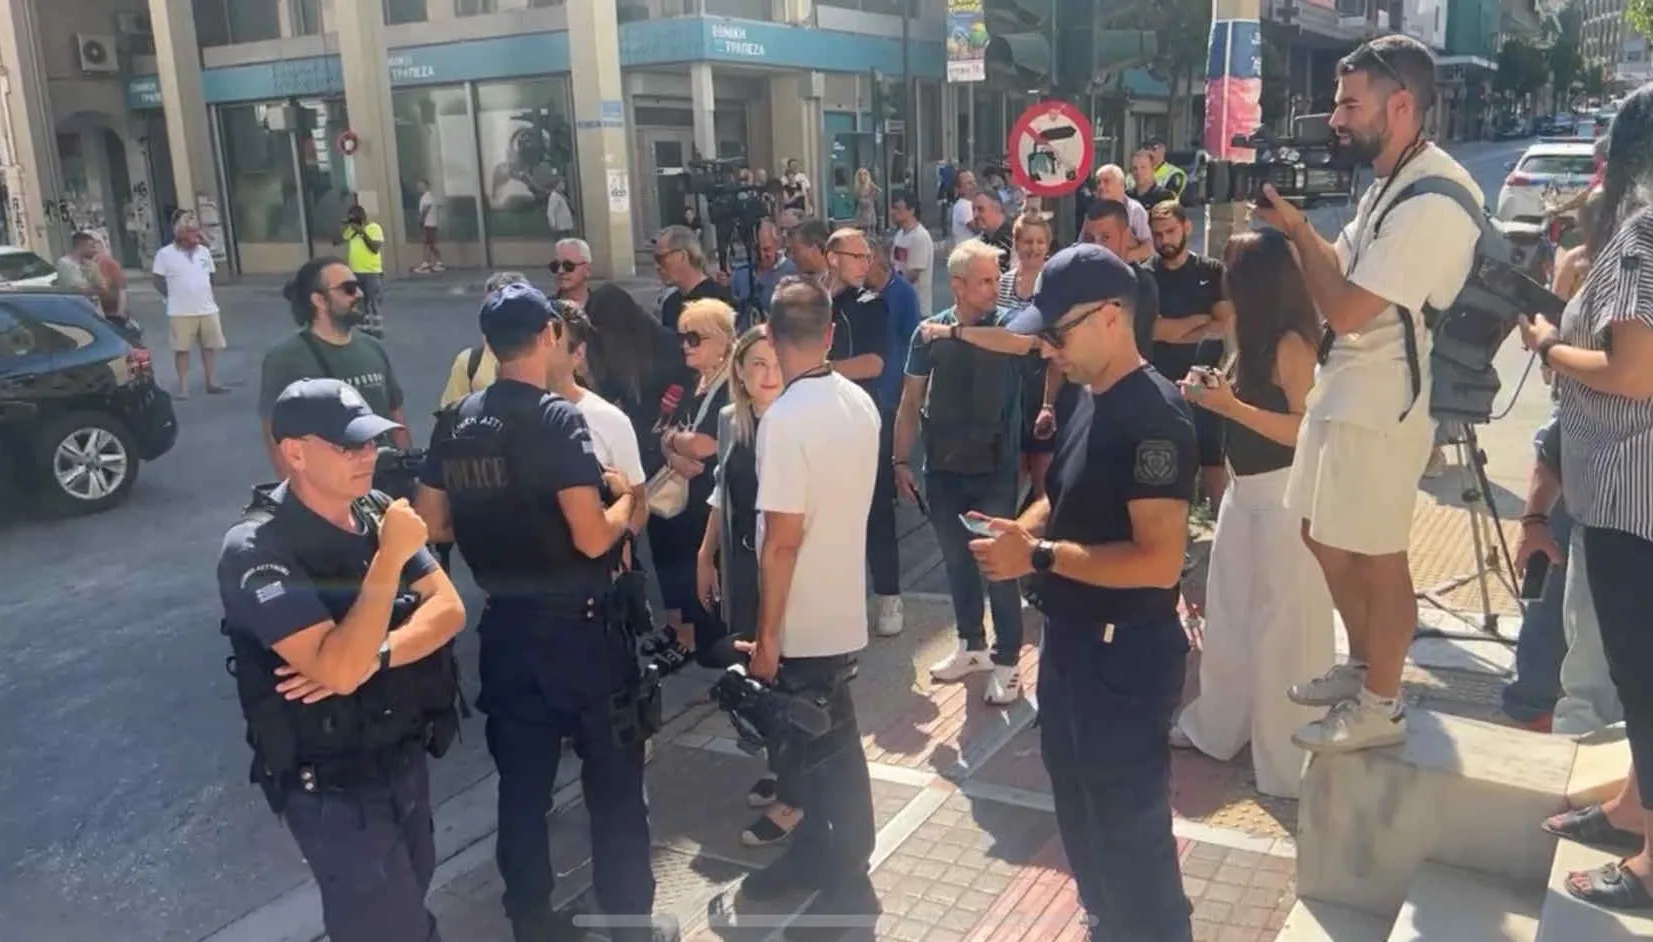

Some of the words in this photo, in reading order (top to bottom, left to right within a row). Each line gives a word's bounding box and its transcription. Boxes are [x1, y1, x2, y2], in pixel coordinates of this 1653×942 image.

[724, 40, 766, 57] ΤΡΑΠΕΖΑ
[391, 65, 436, 80] ΤΡΑΠΕΖΑ
[441, 456, 508, 489] POLICE
